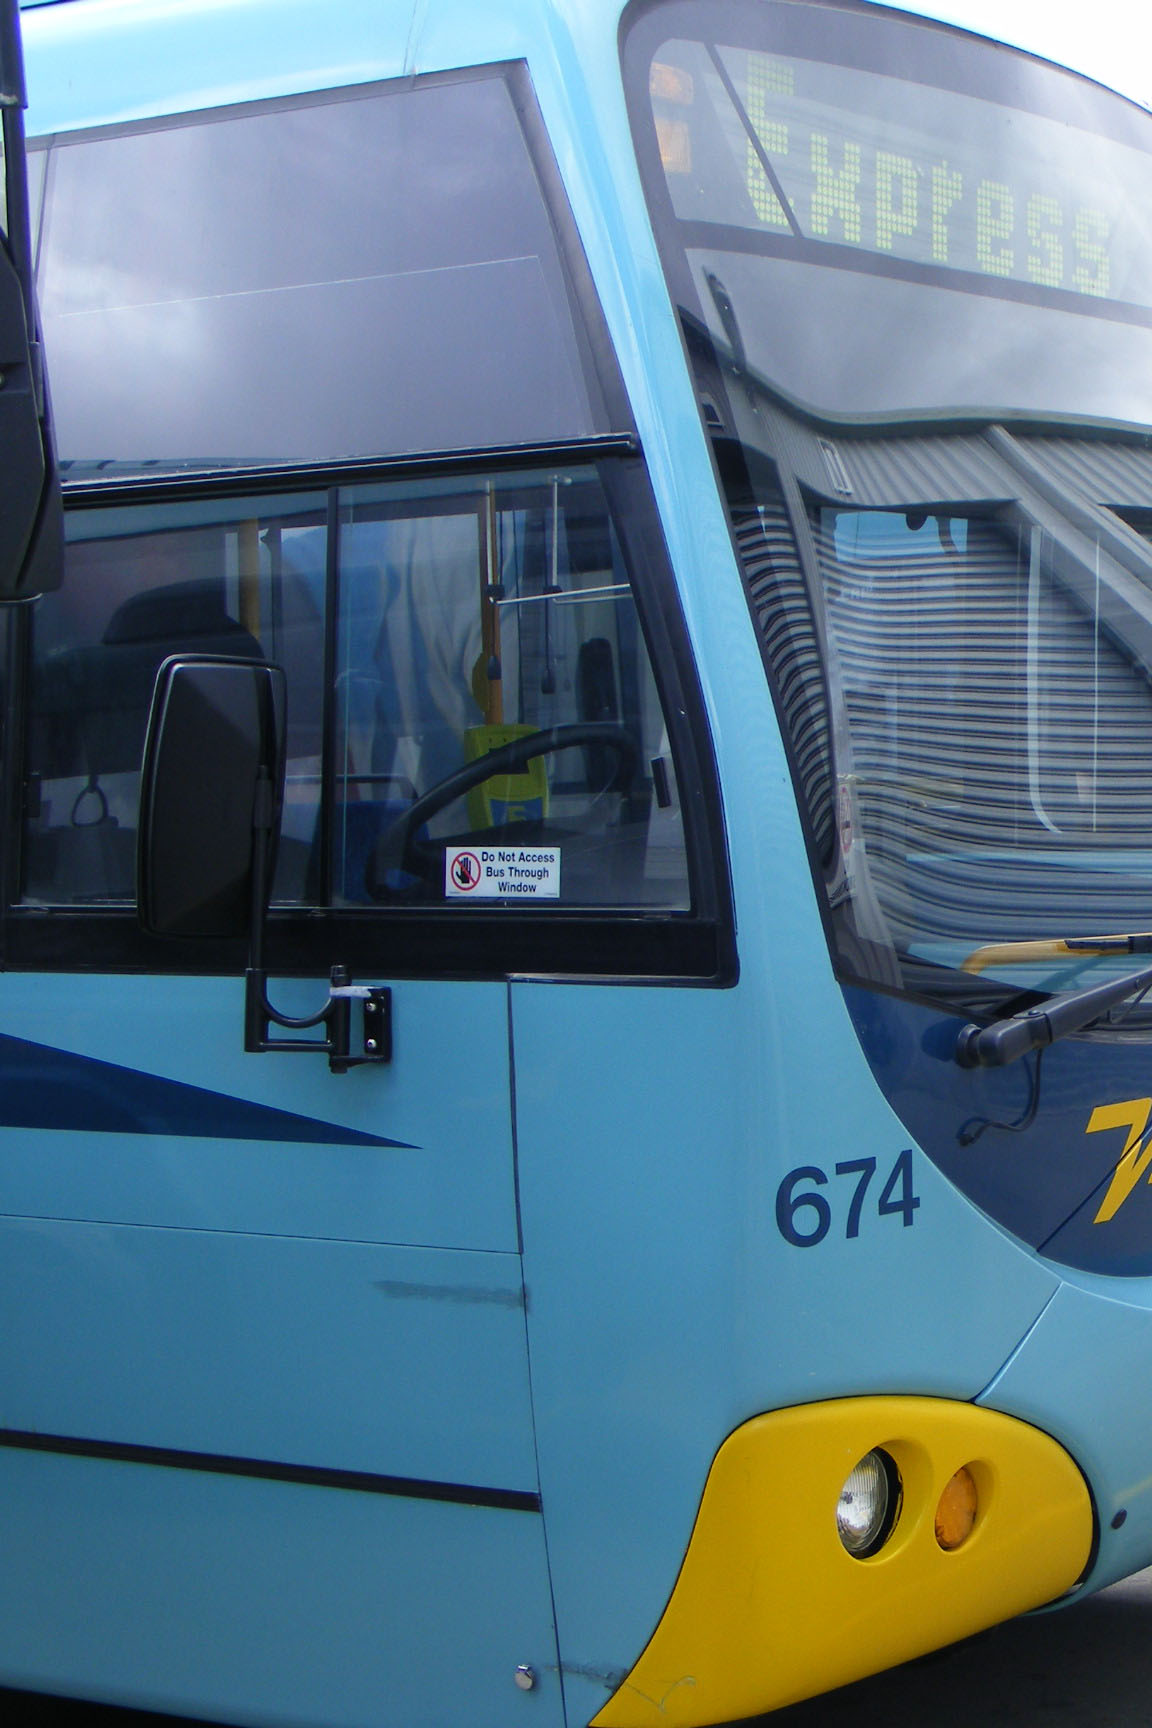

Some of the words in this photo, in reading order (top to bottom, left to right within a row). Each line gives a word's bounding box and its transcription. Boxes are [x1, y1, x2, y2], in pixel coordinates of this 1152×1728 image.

[746, 53, 1110, 297] Express
[482, 852, 495, 862] Do
[498, 852, 516, 862] Not
[519, 852, 555, 862] Access
[486, 867, 505, 878] Bus
[508, 867, 549, 880] Through
[498, 882, 537, 893] Window
[775, 1149, 921, 1248] 674
